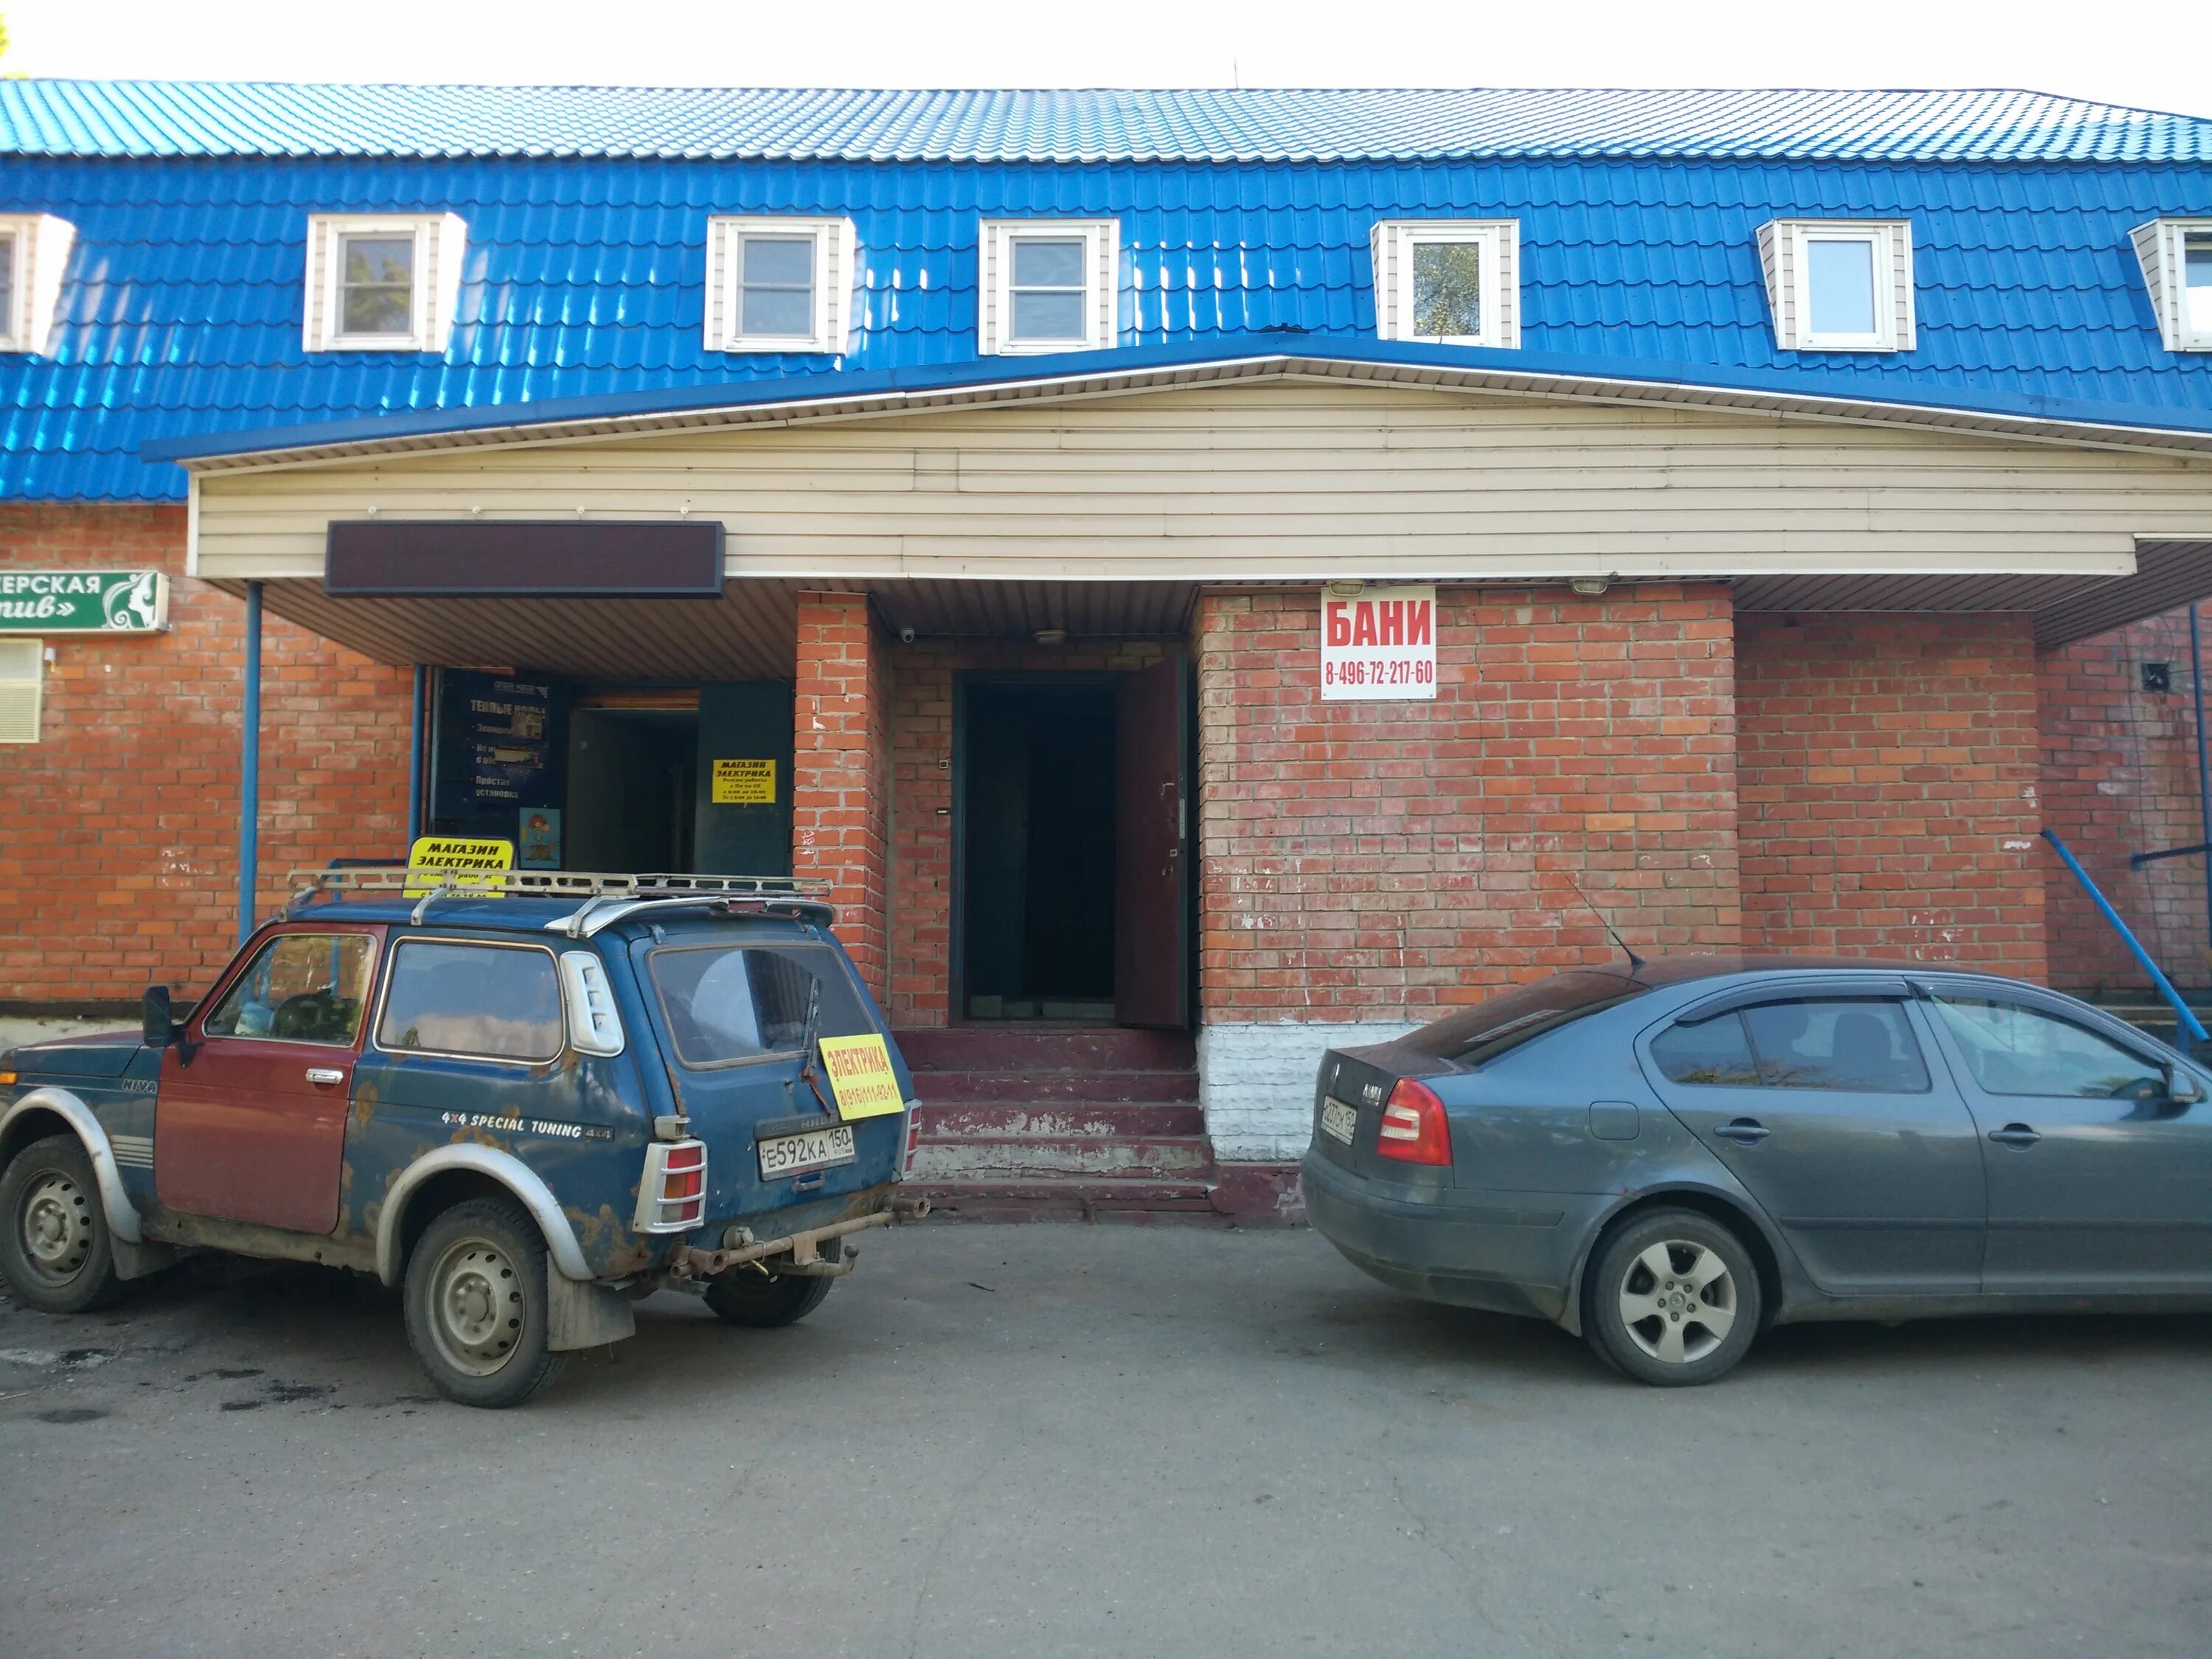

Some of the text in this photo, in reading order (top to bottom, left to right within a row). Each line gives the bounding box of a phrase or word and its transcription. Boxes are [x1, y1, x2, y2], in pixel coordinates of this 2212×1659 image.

[0, 576, 101, 594] ЕРСКАЯ
[1326, 600, 1431, 646] БАНИ
[1326, 660, 1433, 685] 8-496-72-217-60
[470, 700, 512, 715] ТЕПЛЫЕ
[476, 775, 510, 786] Простая
[475, 788, 520, 799] установка
[428, 843, 499, 855] МАГАЗИН
[417, 856, 504, 869] ЭЛЕКТРИКА
[827, 1046, 889, 1078] ЭЛЕКТРИКА
[122, 1079, 158, 1094] NIVA
[470, 1114, 524, 1131] SPECIAL
[532, 1121, 582, 1138] TUNING
